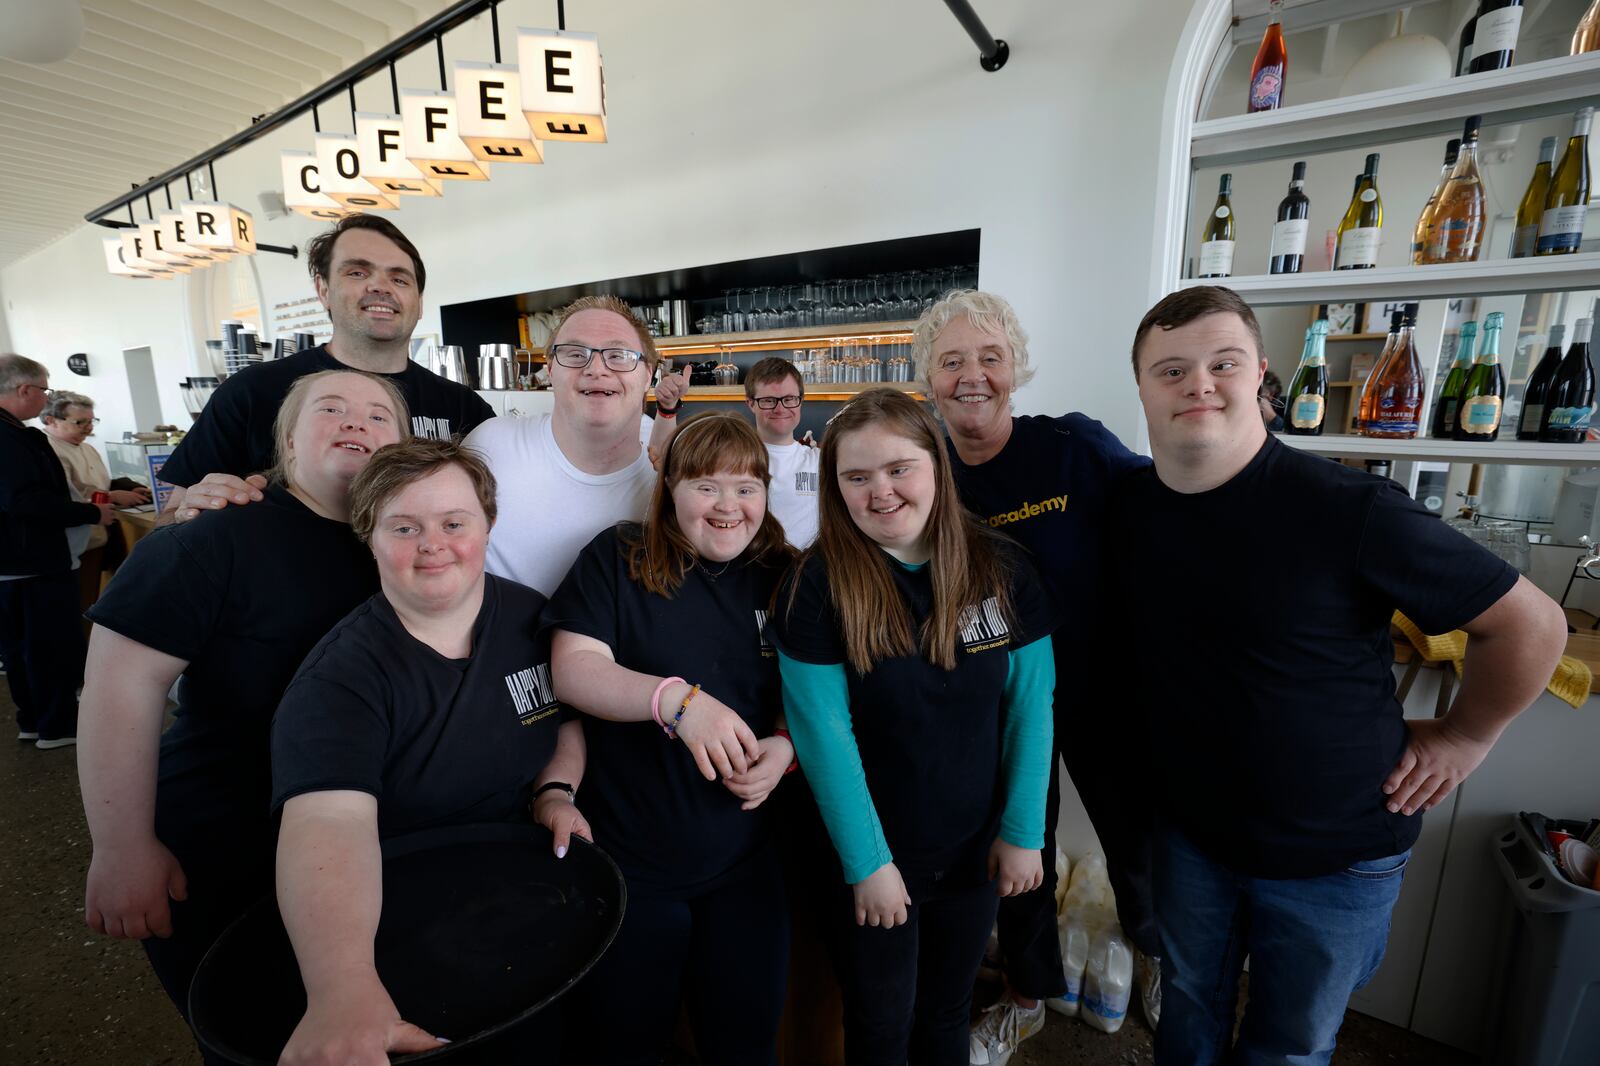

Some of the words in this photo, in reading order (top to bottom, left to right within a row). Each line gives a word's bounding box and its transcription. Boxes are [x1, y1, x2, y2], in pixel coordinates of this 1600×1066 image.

[300, 49, 574, 194] COFFEE
[118, 212, 217, 264] RDER
[412, 416, 437, 441] HAPPY
[436, 418, 452, 442] OUT
[795, 471, 810, 491] HAPPY
[988, 494, 1068, 528] academy
[957, 604, 991, 643] HAPPY
[982, 596, 1009, 637] OUT
[504, 666, 543, 715] HAPPY
[536, 662, 557, 705] OUT
